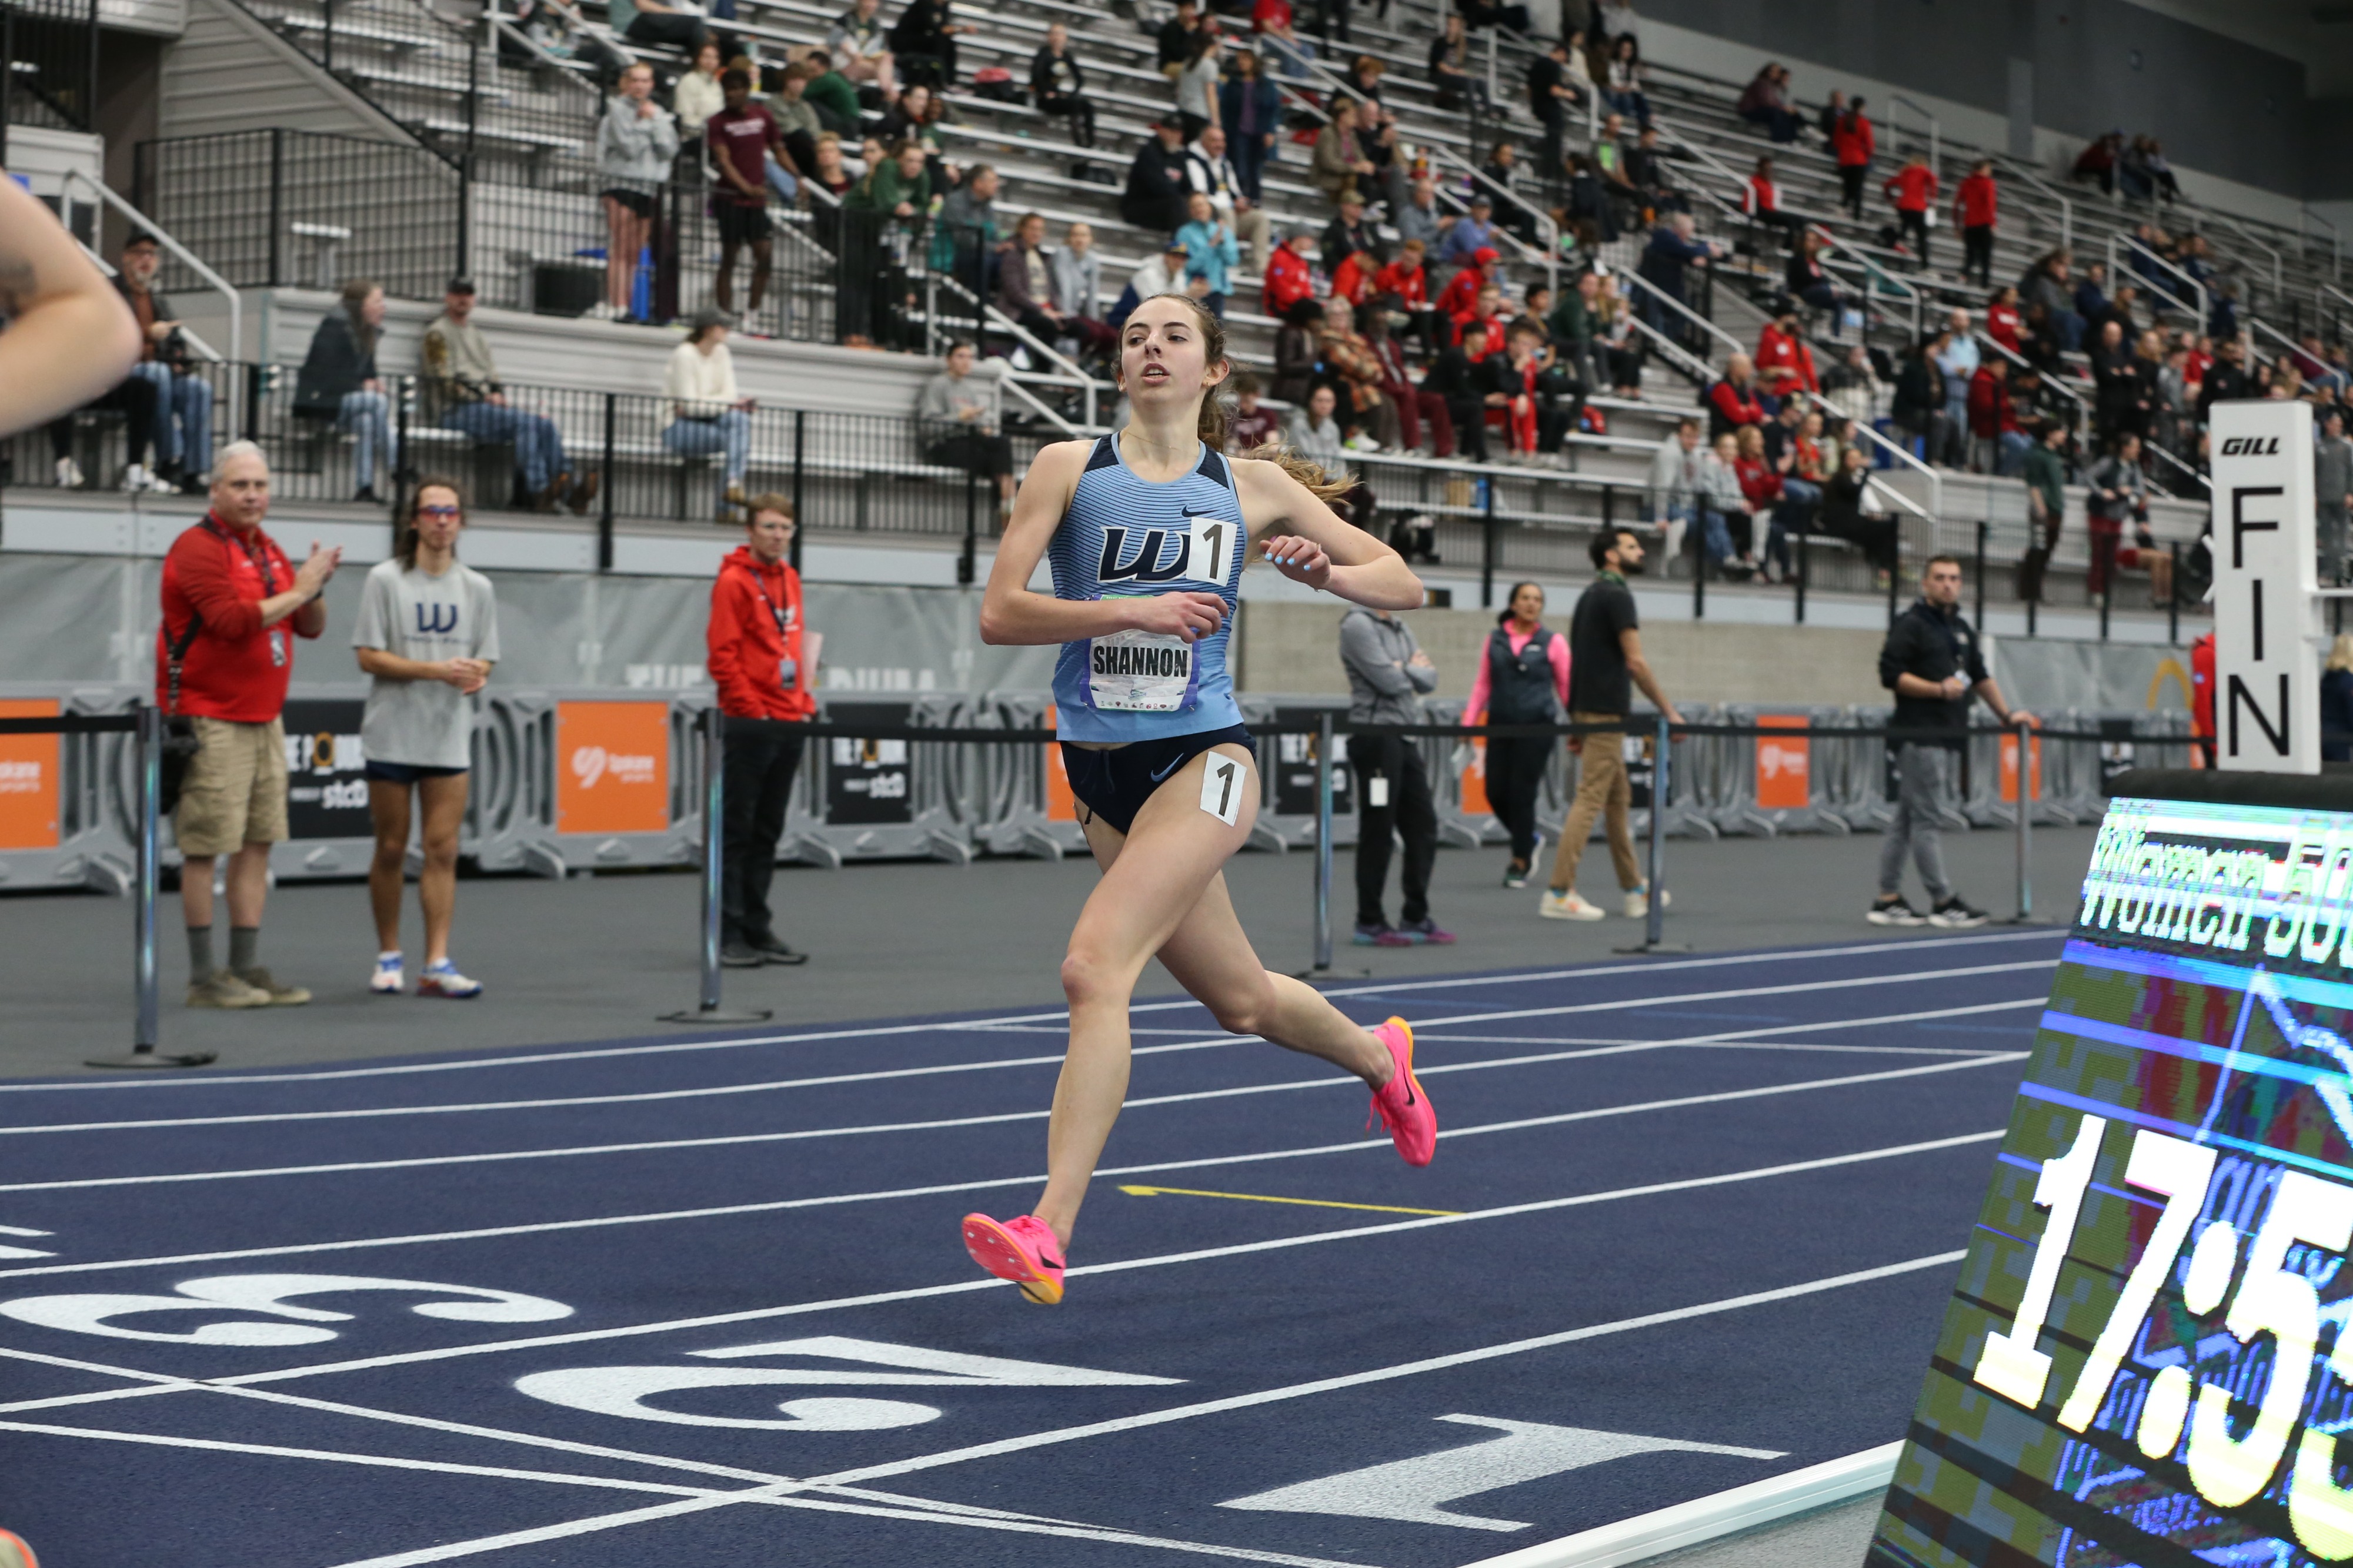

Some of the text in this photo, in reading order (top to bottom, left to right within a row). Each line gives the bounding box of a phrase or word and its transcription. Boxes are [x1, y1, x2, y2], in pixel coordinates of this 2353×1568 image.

[2221, 437, 2280, 456] GILL
[1202, 523, 1223, 580] 1
[1093, 645, 1188, 677] SHANNON
[1216, 762, 1236, 817] 1
[0, 1273, 576, 1347] 3
[515, 1335, 1190, 1432] 2
[1213, 1413, 1792, 1532] 1
